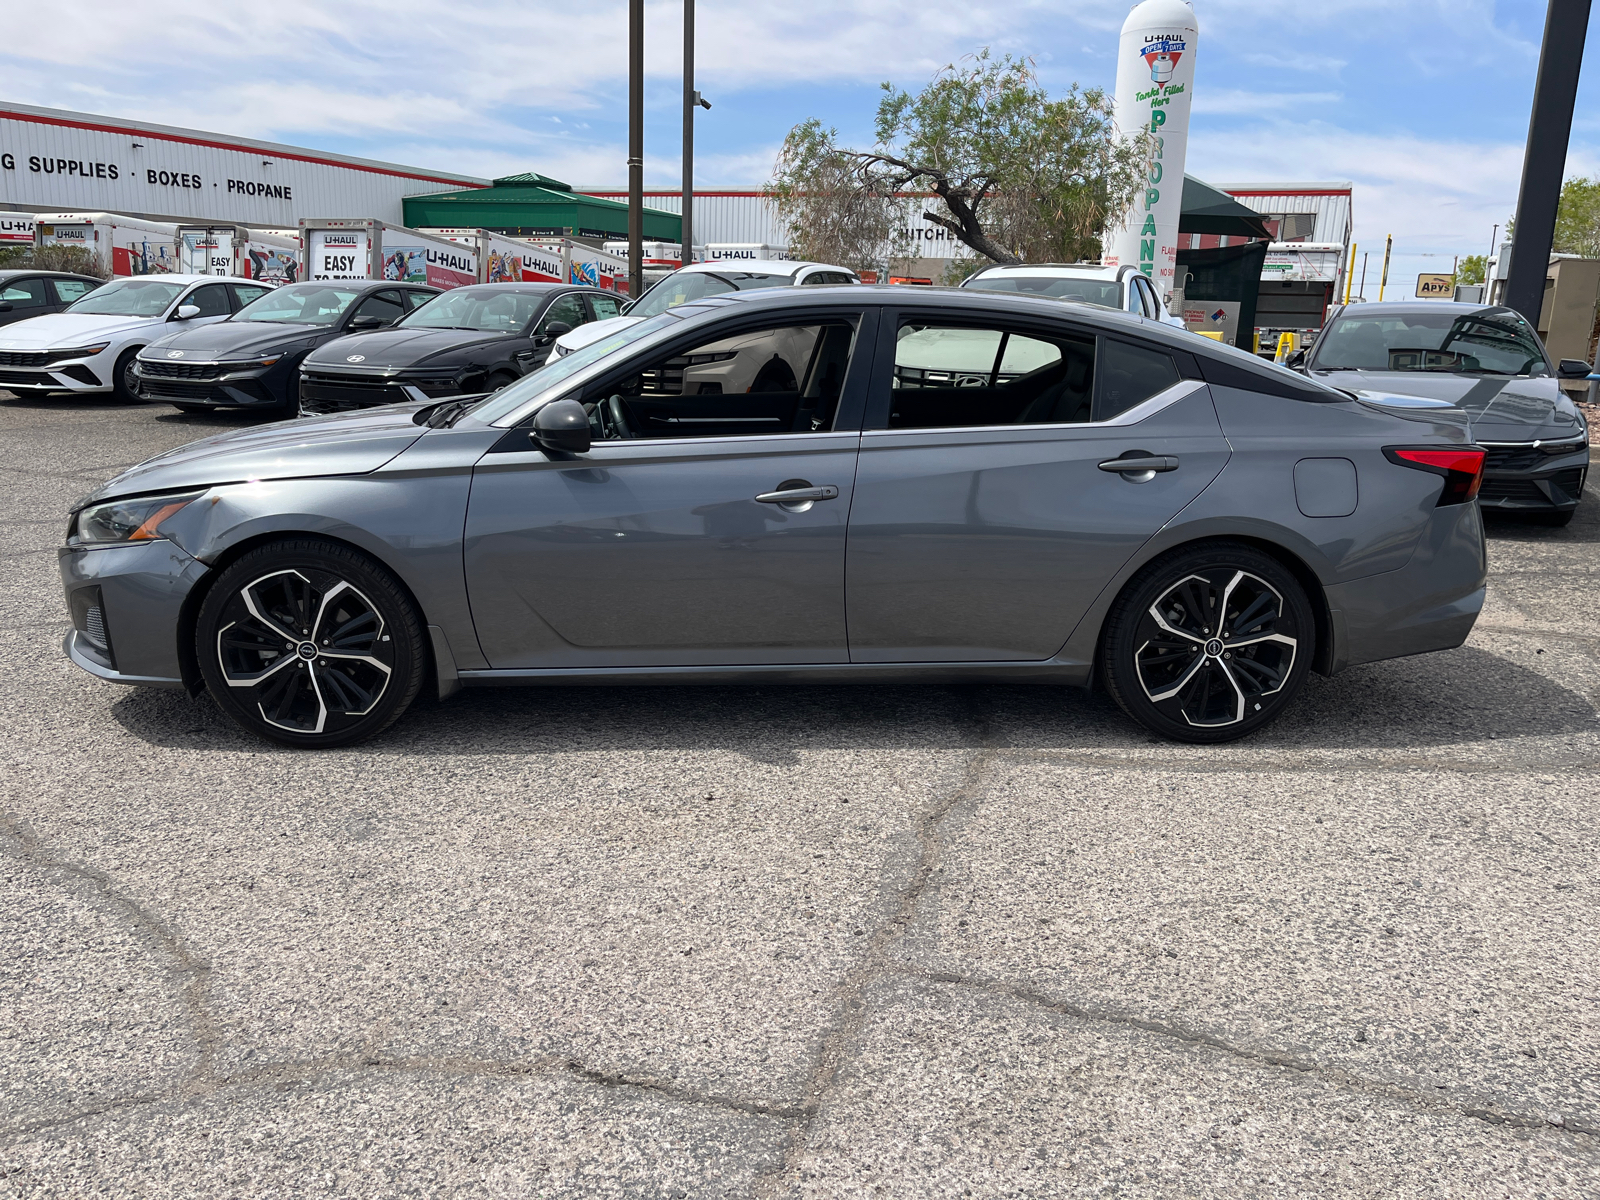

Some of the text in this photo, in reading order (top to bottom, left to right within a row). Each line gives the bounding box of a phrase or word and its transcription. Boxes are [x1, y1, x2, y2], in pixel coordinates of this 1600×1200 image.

[1145, 34, 1184, 42] U-HAUL
[1145, 43, 1162, 53] OPEN
[1135, 83, 1185, 102] Tanks Filled
[1150, 97, 1170, 109] Here
[29, 156, 119, 180] SUPPLIES
[147, 169, 202, 189] BOXES
[227, 179, 292, 200] PROPANE
[1140, 110, 1166, 277] PROPANE
[57, 230, 85, 239] U-HAUL
[325, 236, 357, 244] U-HAUL
[712, 250, 757, 259] U-HAUL
[211, 257, 231, 267] EASY
[324, 255, 356, 271] EASY
[426, 248, 474, 273] U-HAUL
[523, 255, 560, 276] U-HAUL
[216, 268, 226, 276] TO
